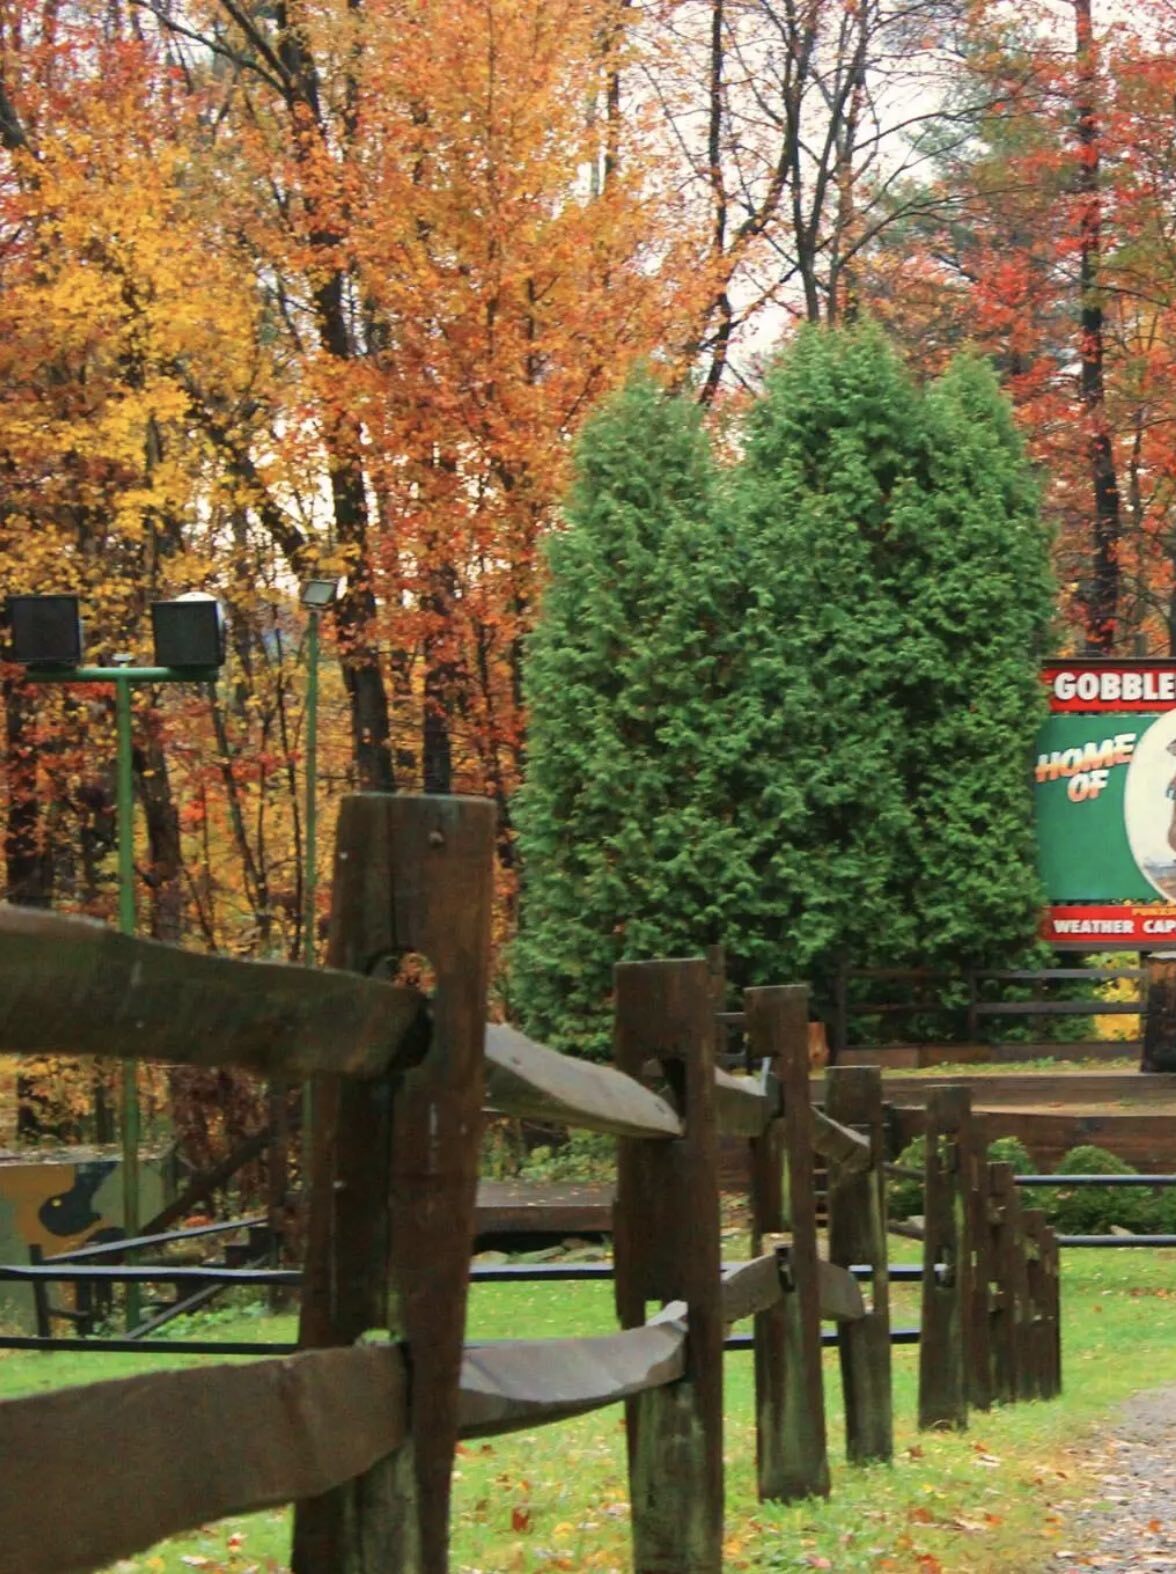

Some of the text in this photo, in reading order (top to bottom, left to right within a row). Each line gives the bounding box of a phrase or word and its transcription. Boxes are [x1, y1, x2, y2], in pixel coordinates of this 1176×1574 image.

[1034, 732, 1137, 783] HOME
[1066, 768, 1110, 803] OF
[1052, 919, 1136, 934] WEATHER
